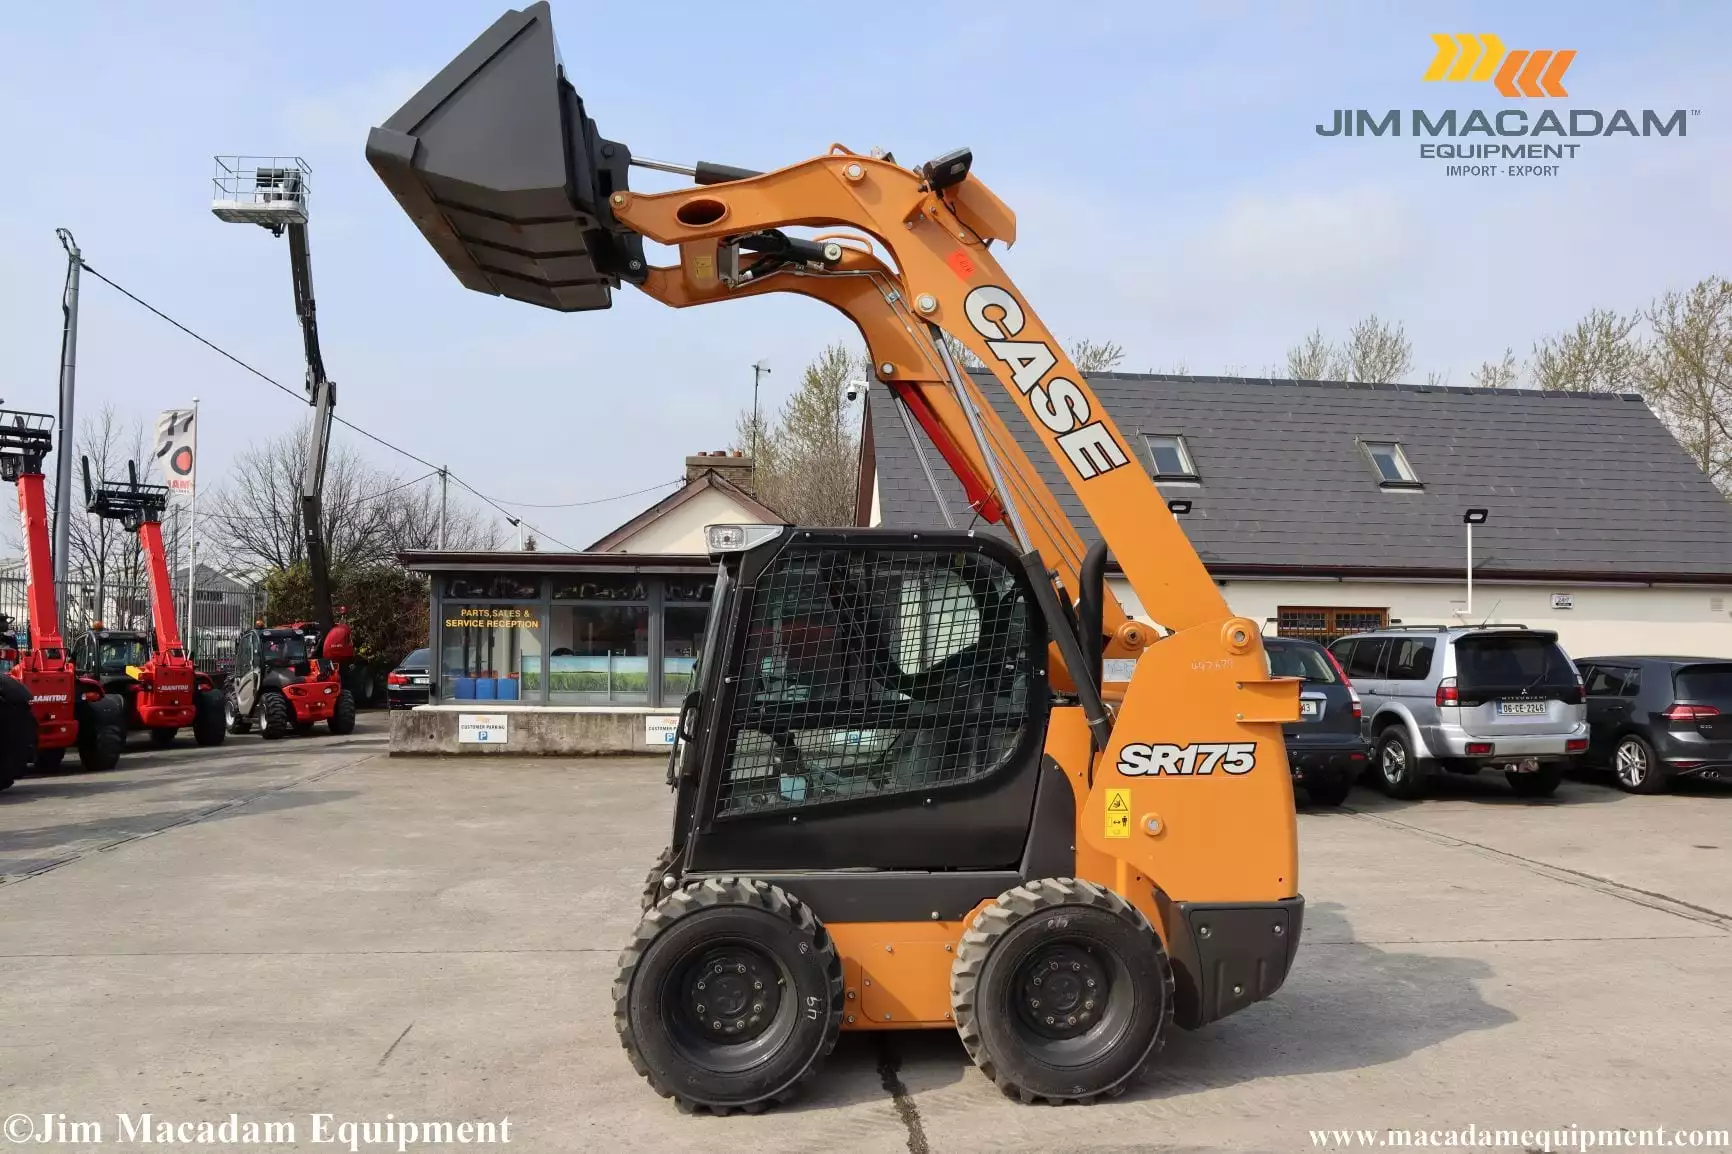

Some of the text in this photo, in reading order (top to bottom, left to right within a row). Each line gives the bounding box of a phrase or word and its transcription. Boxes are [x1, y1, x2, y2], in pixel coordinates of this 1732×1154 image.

[964, 284, 1131, 481] CASE
[445, 619, 539, 629] SERVICE RECEPTION
[1116, 742, 1257, 777] SR175
